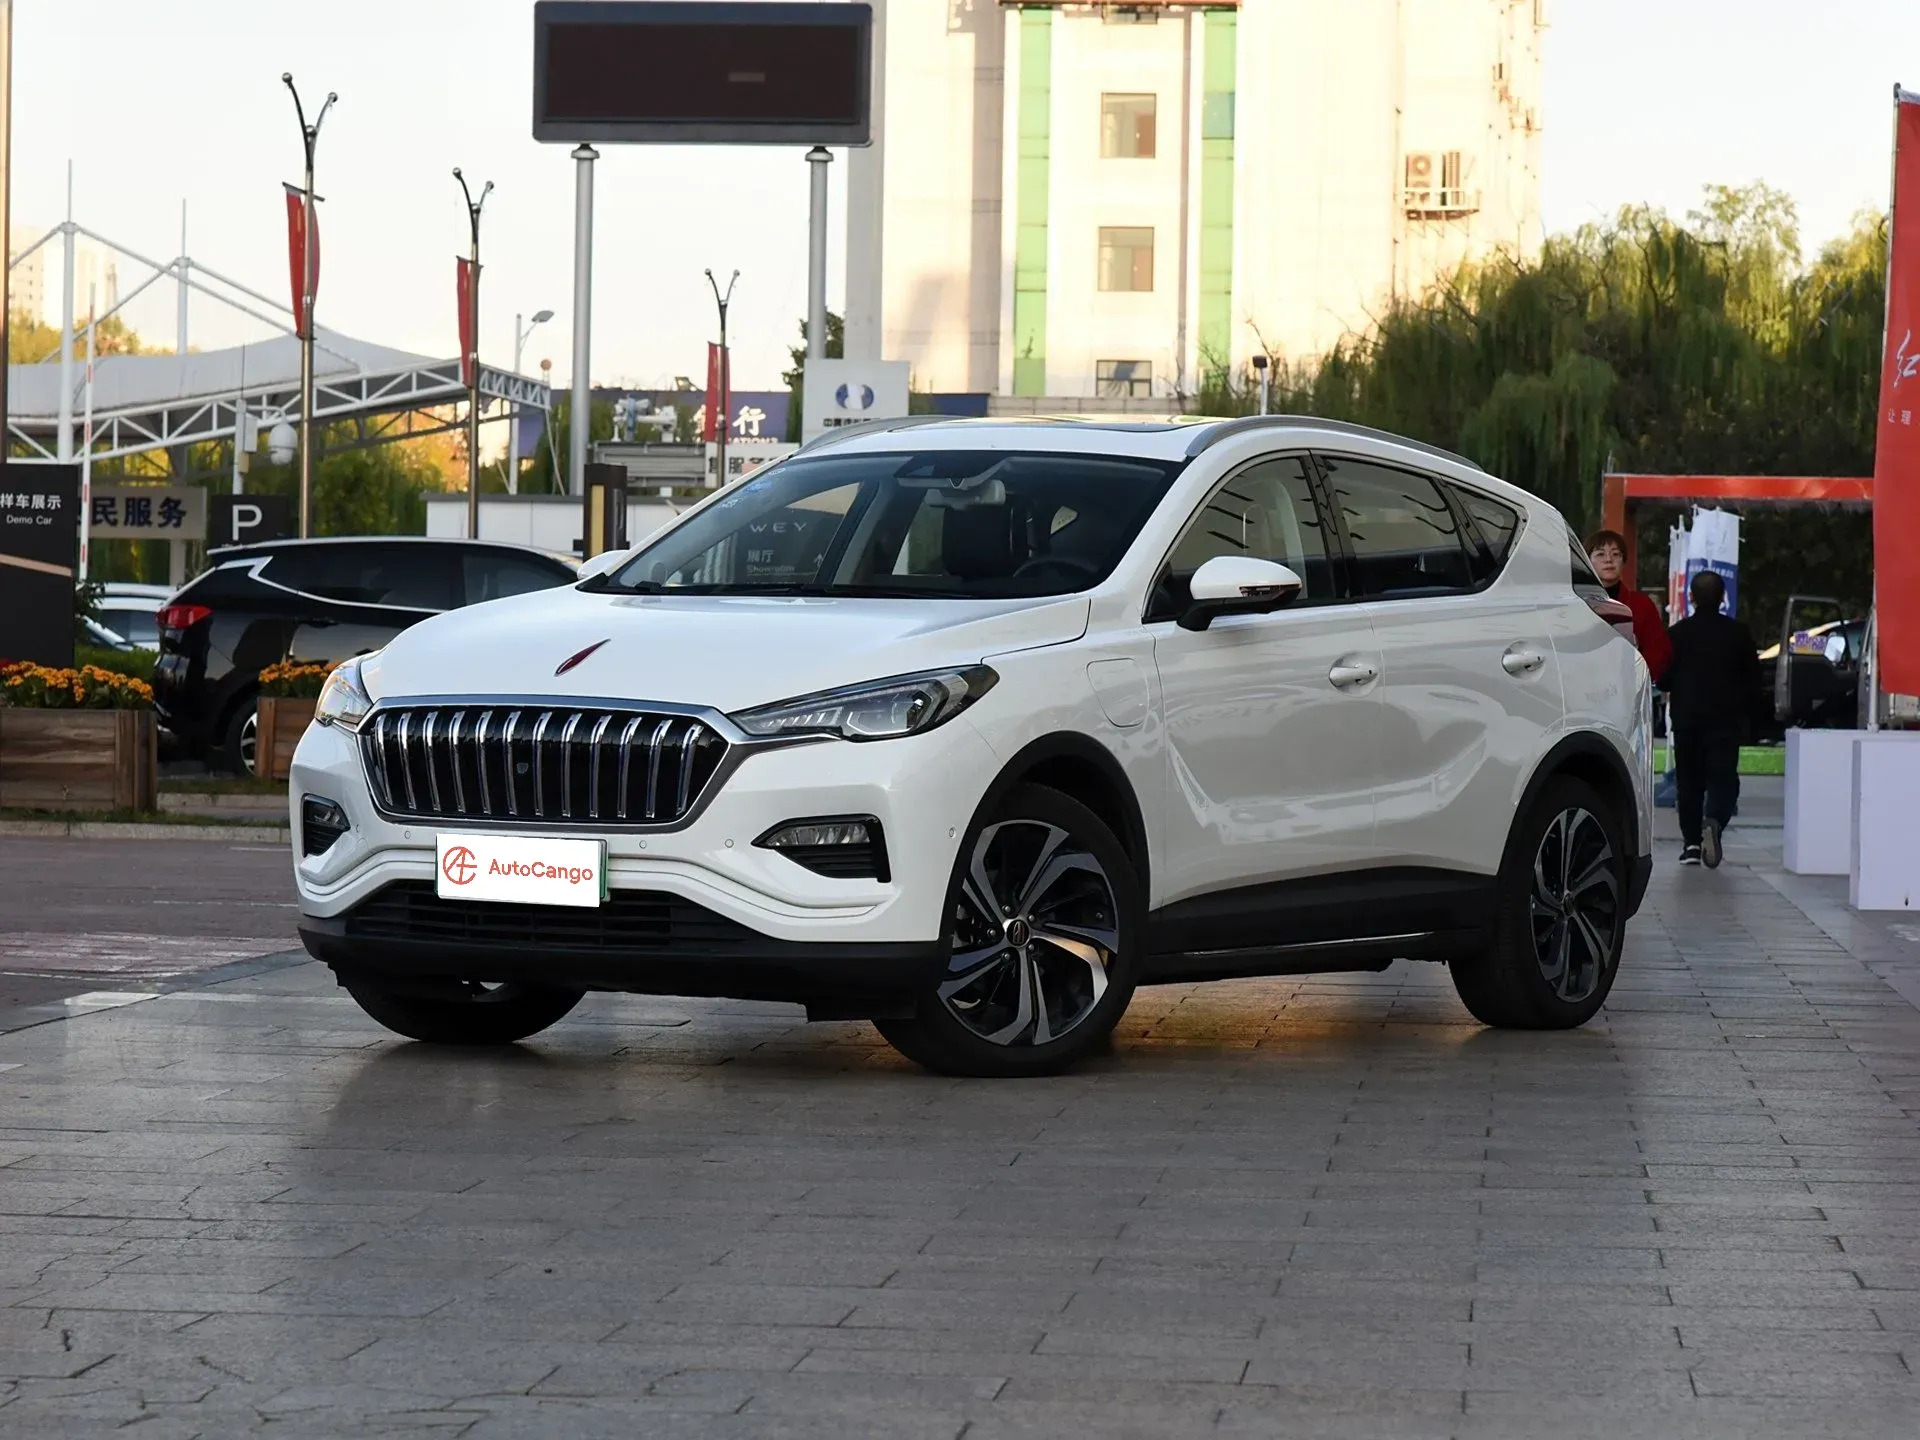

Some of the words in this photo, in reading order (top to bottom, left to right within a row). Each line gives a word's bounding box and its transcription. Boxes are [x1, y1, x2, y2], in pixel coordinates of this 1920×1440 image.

[0, 493, 62, 509] 样车展示
[77, 496, 187, 528] 民服务
[6, 514, 33, 525] Demo
[36, 515, 53, 525] Car
[232, 504, 263, 541] P
